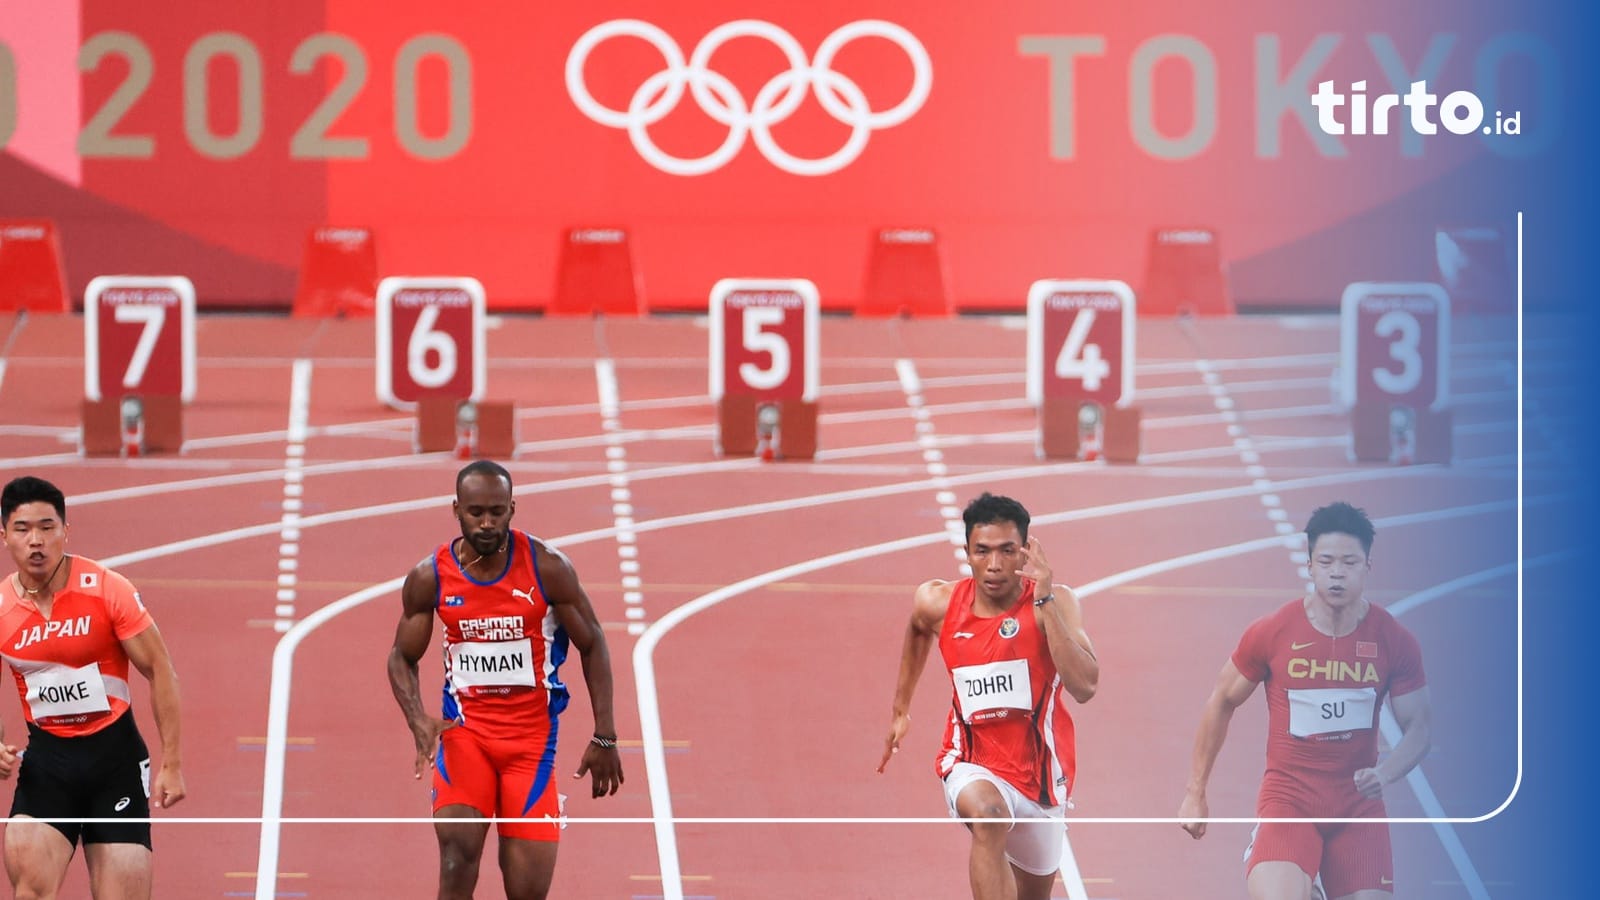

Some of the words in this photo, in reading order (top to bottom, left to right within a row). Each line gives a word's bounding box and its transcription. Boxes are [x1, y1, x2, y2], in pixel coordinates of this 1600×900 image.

[75, 30, 473, 161] 2020
[1018, 33, 1564, 161] TOKYO
[114, 304, 166, 388] 7
[407, 303, 458, 388] 6
[738, 305, 791, 390] 5
[1055, 307, 1110, 391] 4
[1372, 309, 1423, 394] 3
[14, 615, 91, 650] JAPAN
[459, 615, 524, 631] CAYMAN
[38, 681, 90, 703] KOIKE
[459, 652, 524, 673] HYMAN
[965, 674, 1014, 697] ZOHRI
[1287, 658, 1380, 682] CHINA
[1321, 701, 1345, 720] SU
